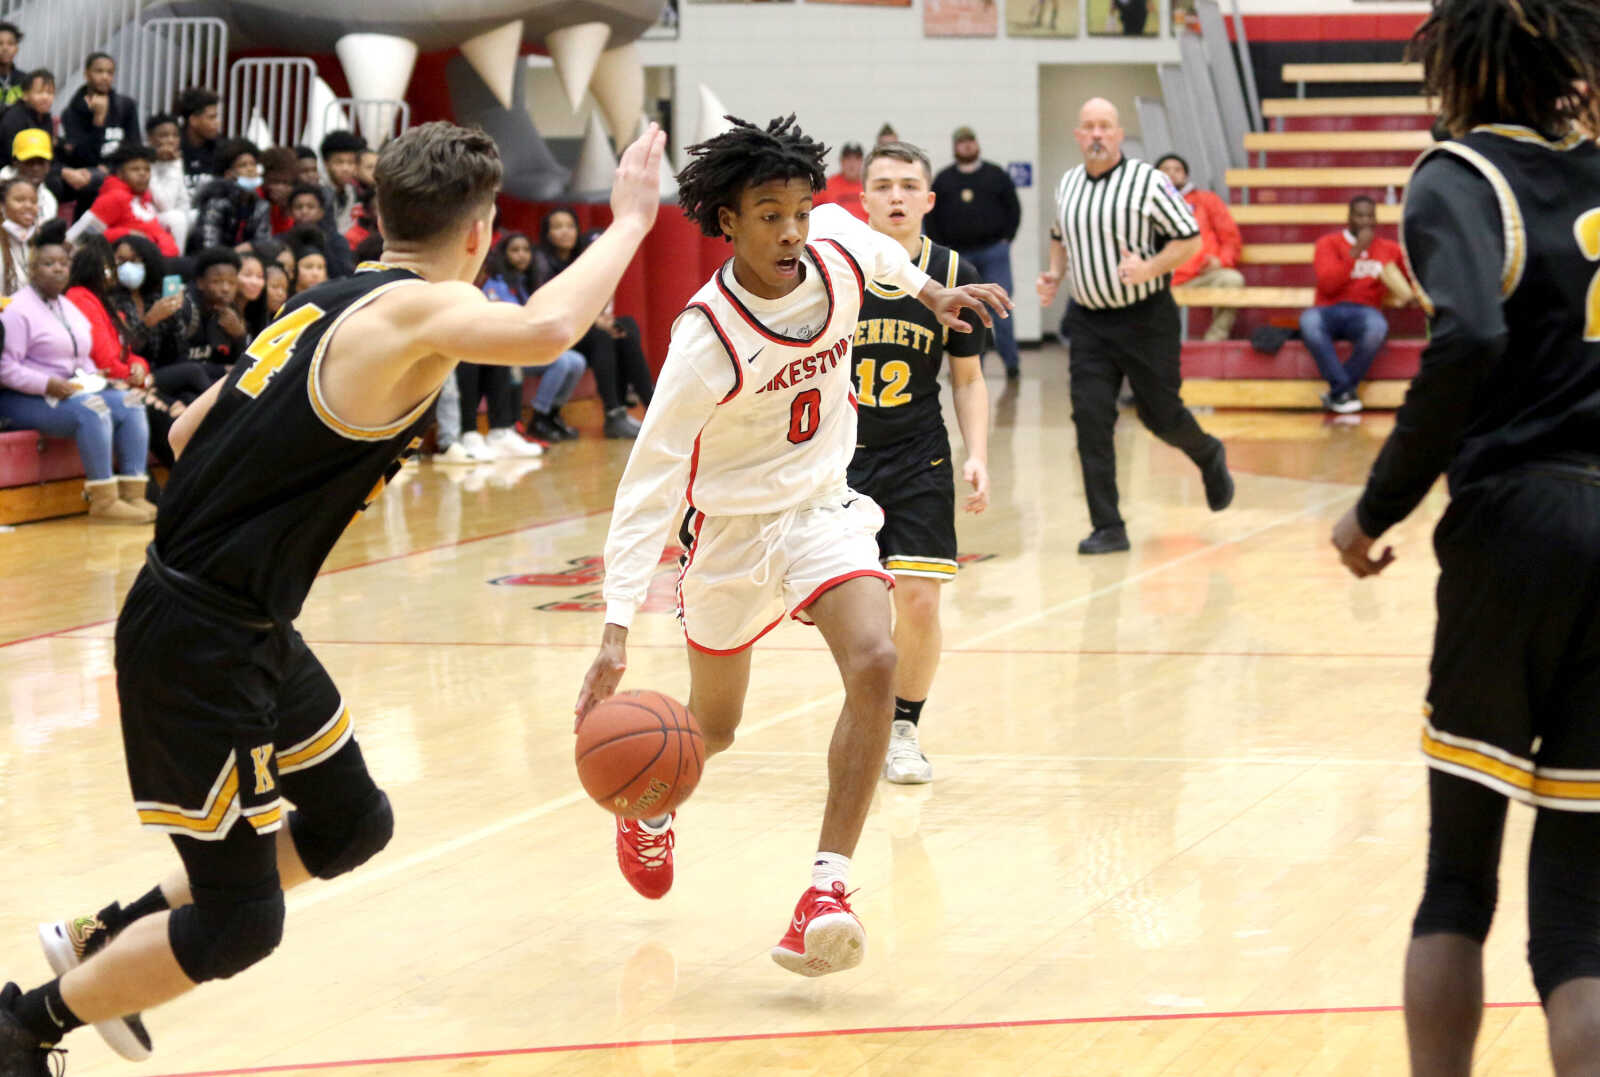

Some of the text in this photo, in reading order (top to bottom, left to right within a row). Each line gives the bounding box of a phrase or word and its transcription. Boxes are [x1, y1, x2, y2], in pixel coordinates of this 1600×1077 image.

[852, 318, 935, 355] ENNETT
[856, 357, 912, 408] 12
[786, 387, 822, 445] 0
[250, 742, 275, 796] K
